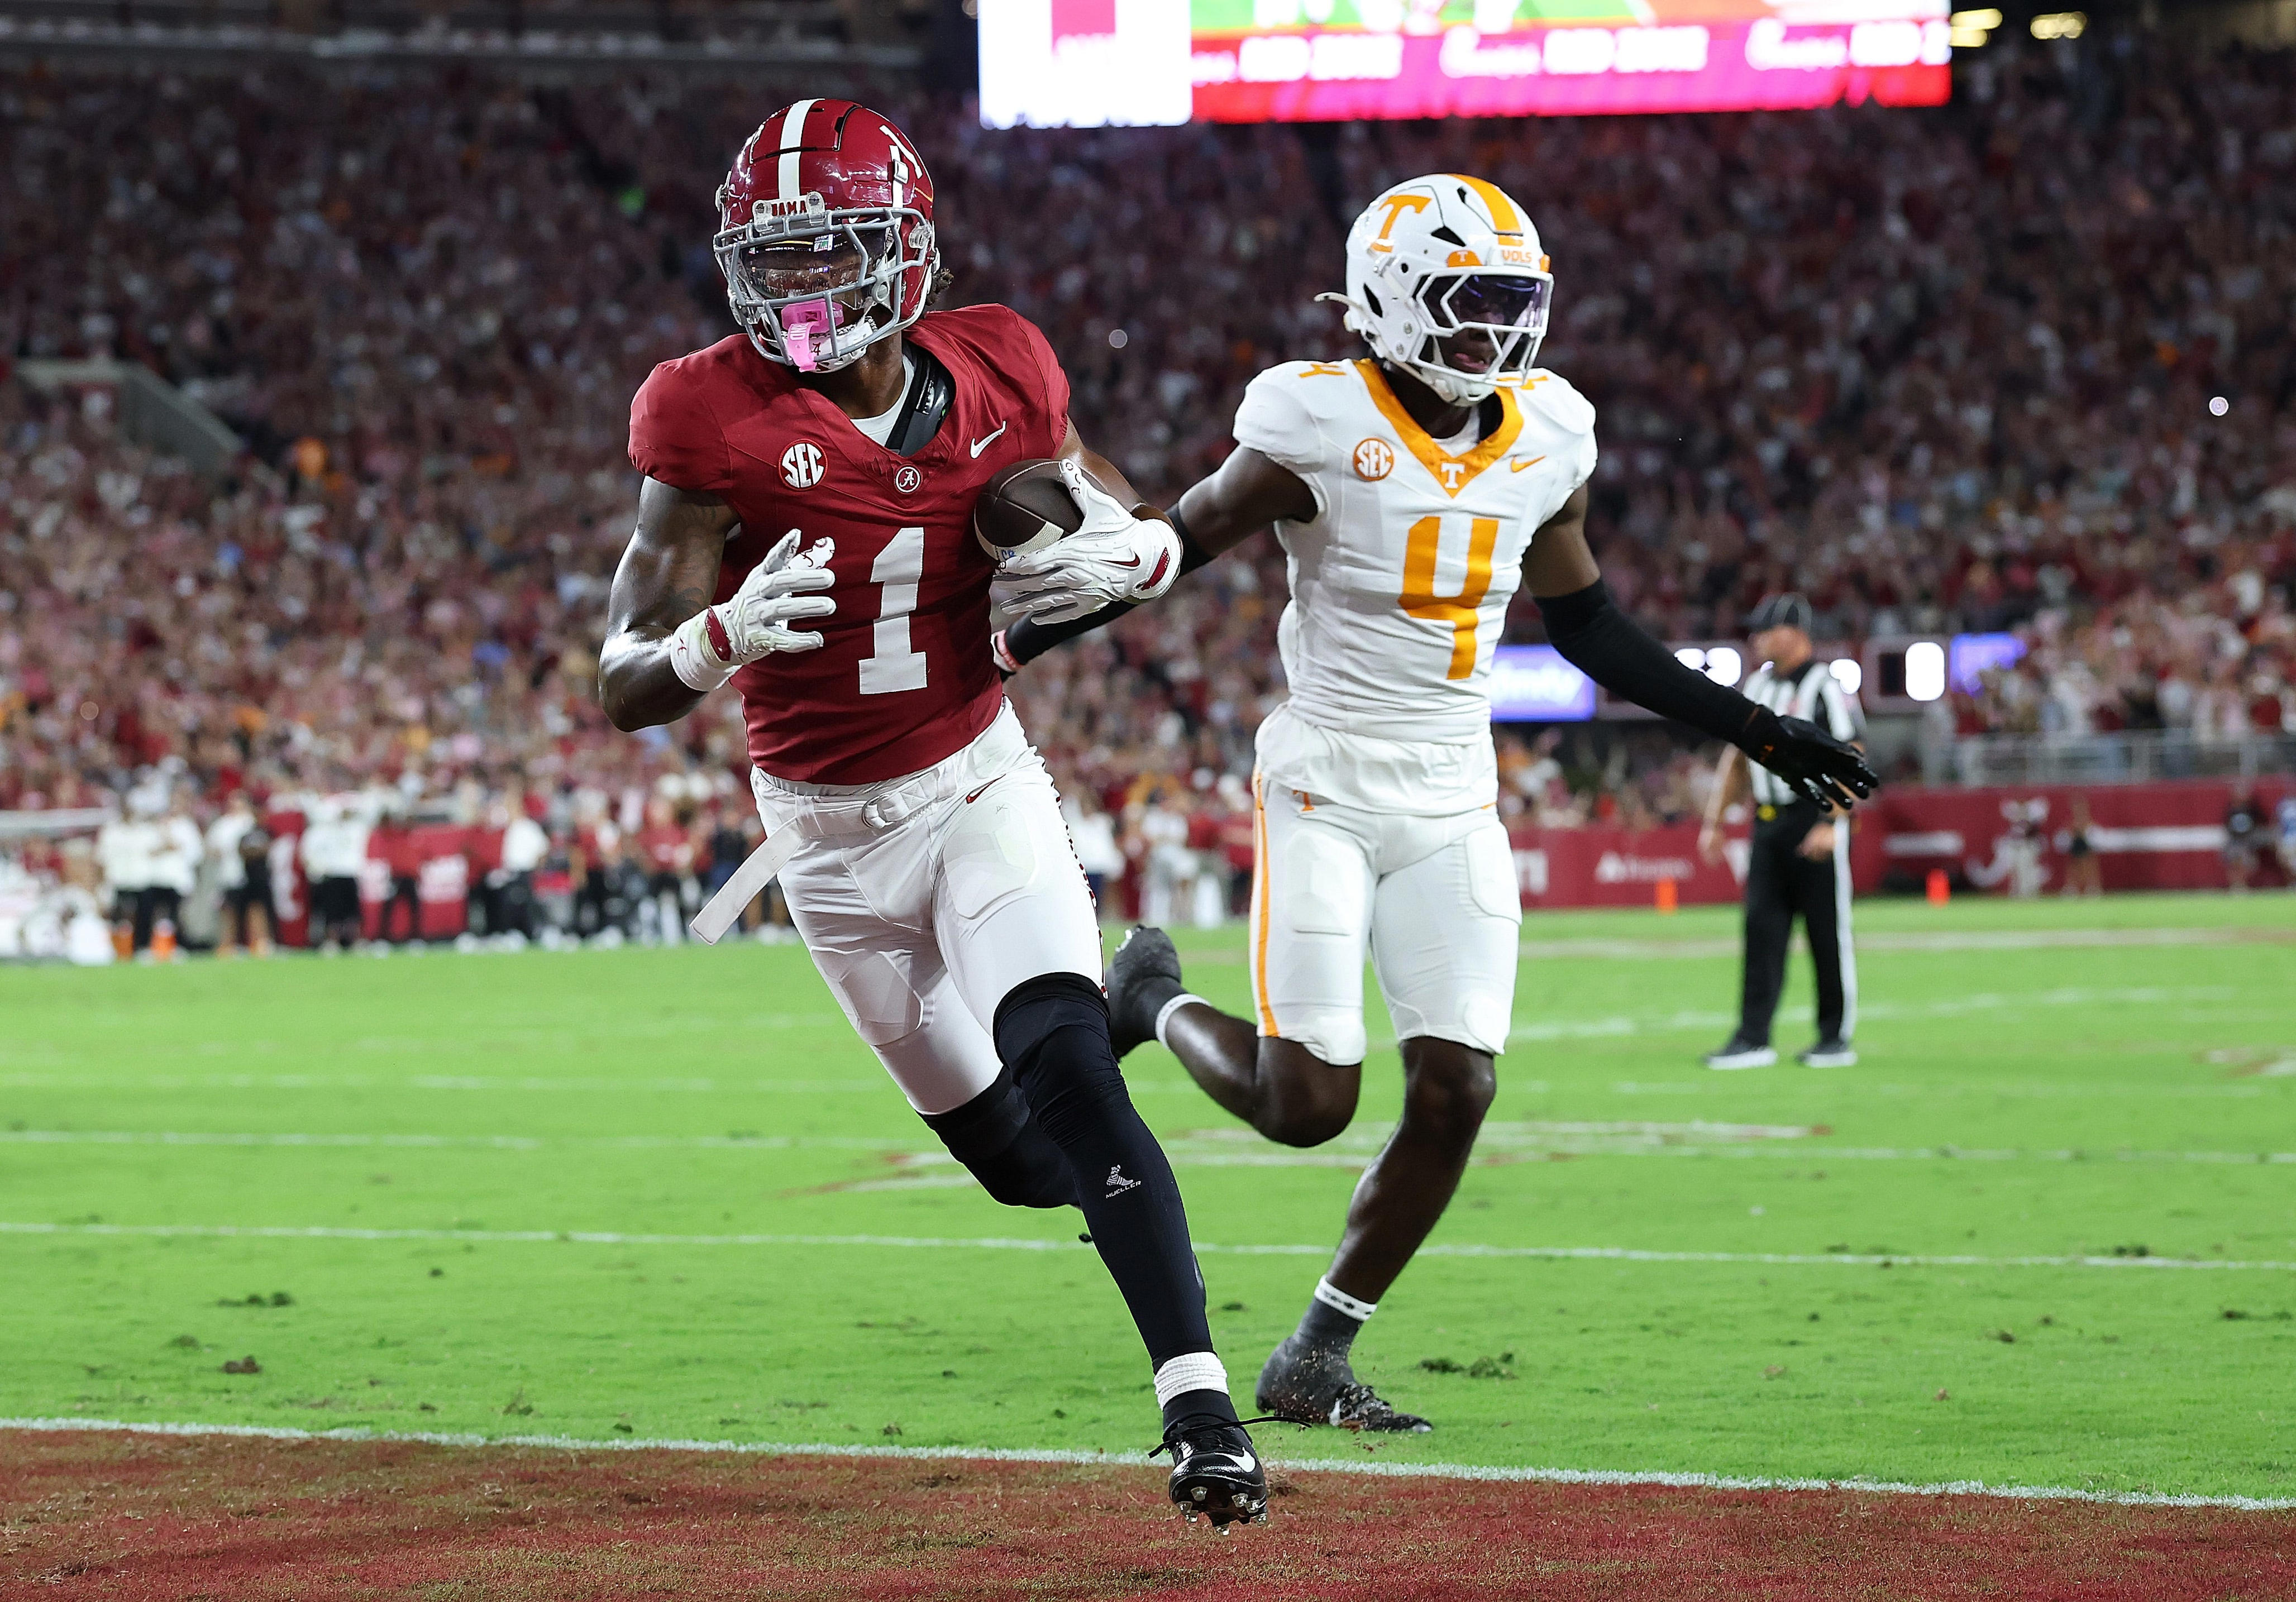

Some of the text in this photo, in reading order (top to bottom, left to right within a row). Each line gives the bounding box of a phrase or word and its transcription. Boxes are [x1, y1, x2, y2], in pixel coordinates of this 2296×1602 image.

[771, 200, 808, 216] BAMA
[1370, 195, 1431, 252] T
[1457, 250, 1468, 262] T
[1502, 249, 1532, 263] VOLS
[782, 443, 824, 488] SEC
[1355, 440, 1392, 477] SEC
[899, 470, 915, 487] A
[1440, 462, 1465, 489] T
[859, 527, 928, 695] 1
[1397, 515, 1500, 680] 4
[1106, 1180, 1141, 1199] MUELLER
